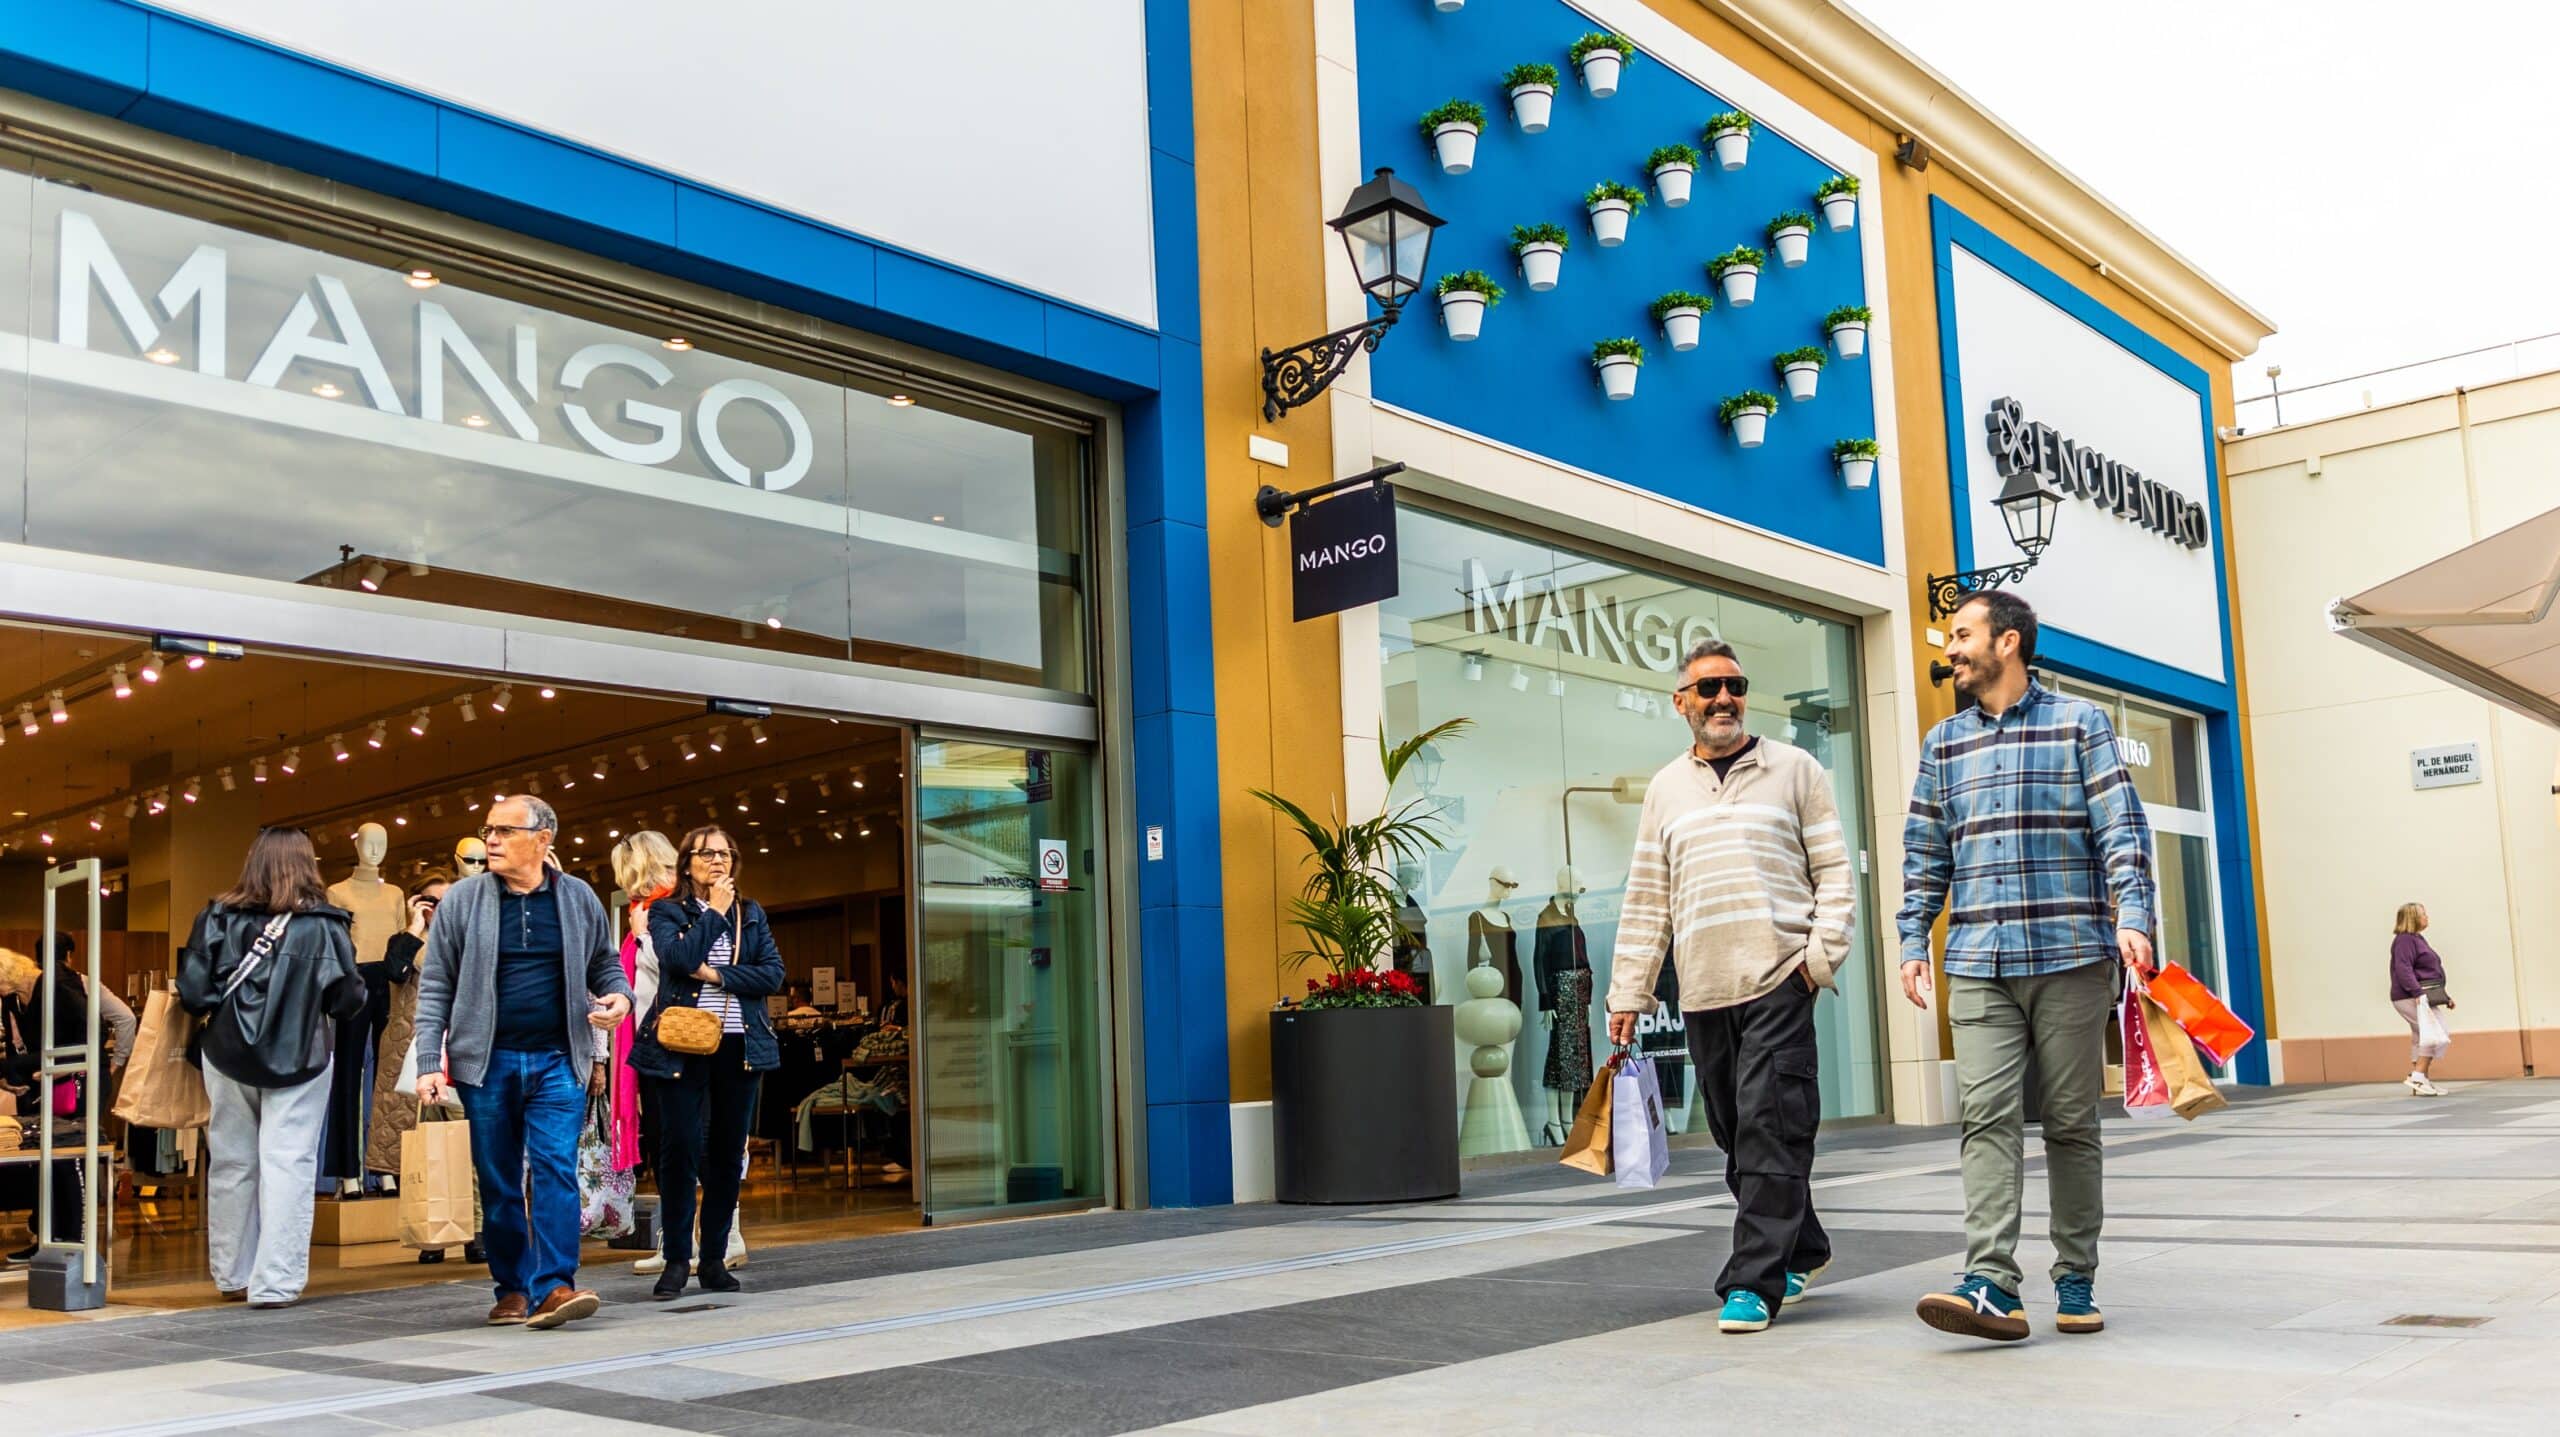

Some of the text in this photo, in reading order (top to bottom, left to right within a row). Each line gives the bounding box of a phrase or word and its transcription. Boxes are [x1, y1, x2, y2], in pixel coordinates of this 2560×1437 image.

[57, 208, 814, 491] MANGO
[2031, 421, 2208, 550] ENCUENTRO
[1300, 533, 1386, 572] MANGO
[2431, 757, 2441, 766] DE
[2443, 752, 2473, 764] MIGUEL
